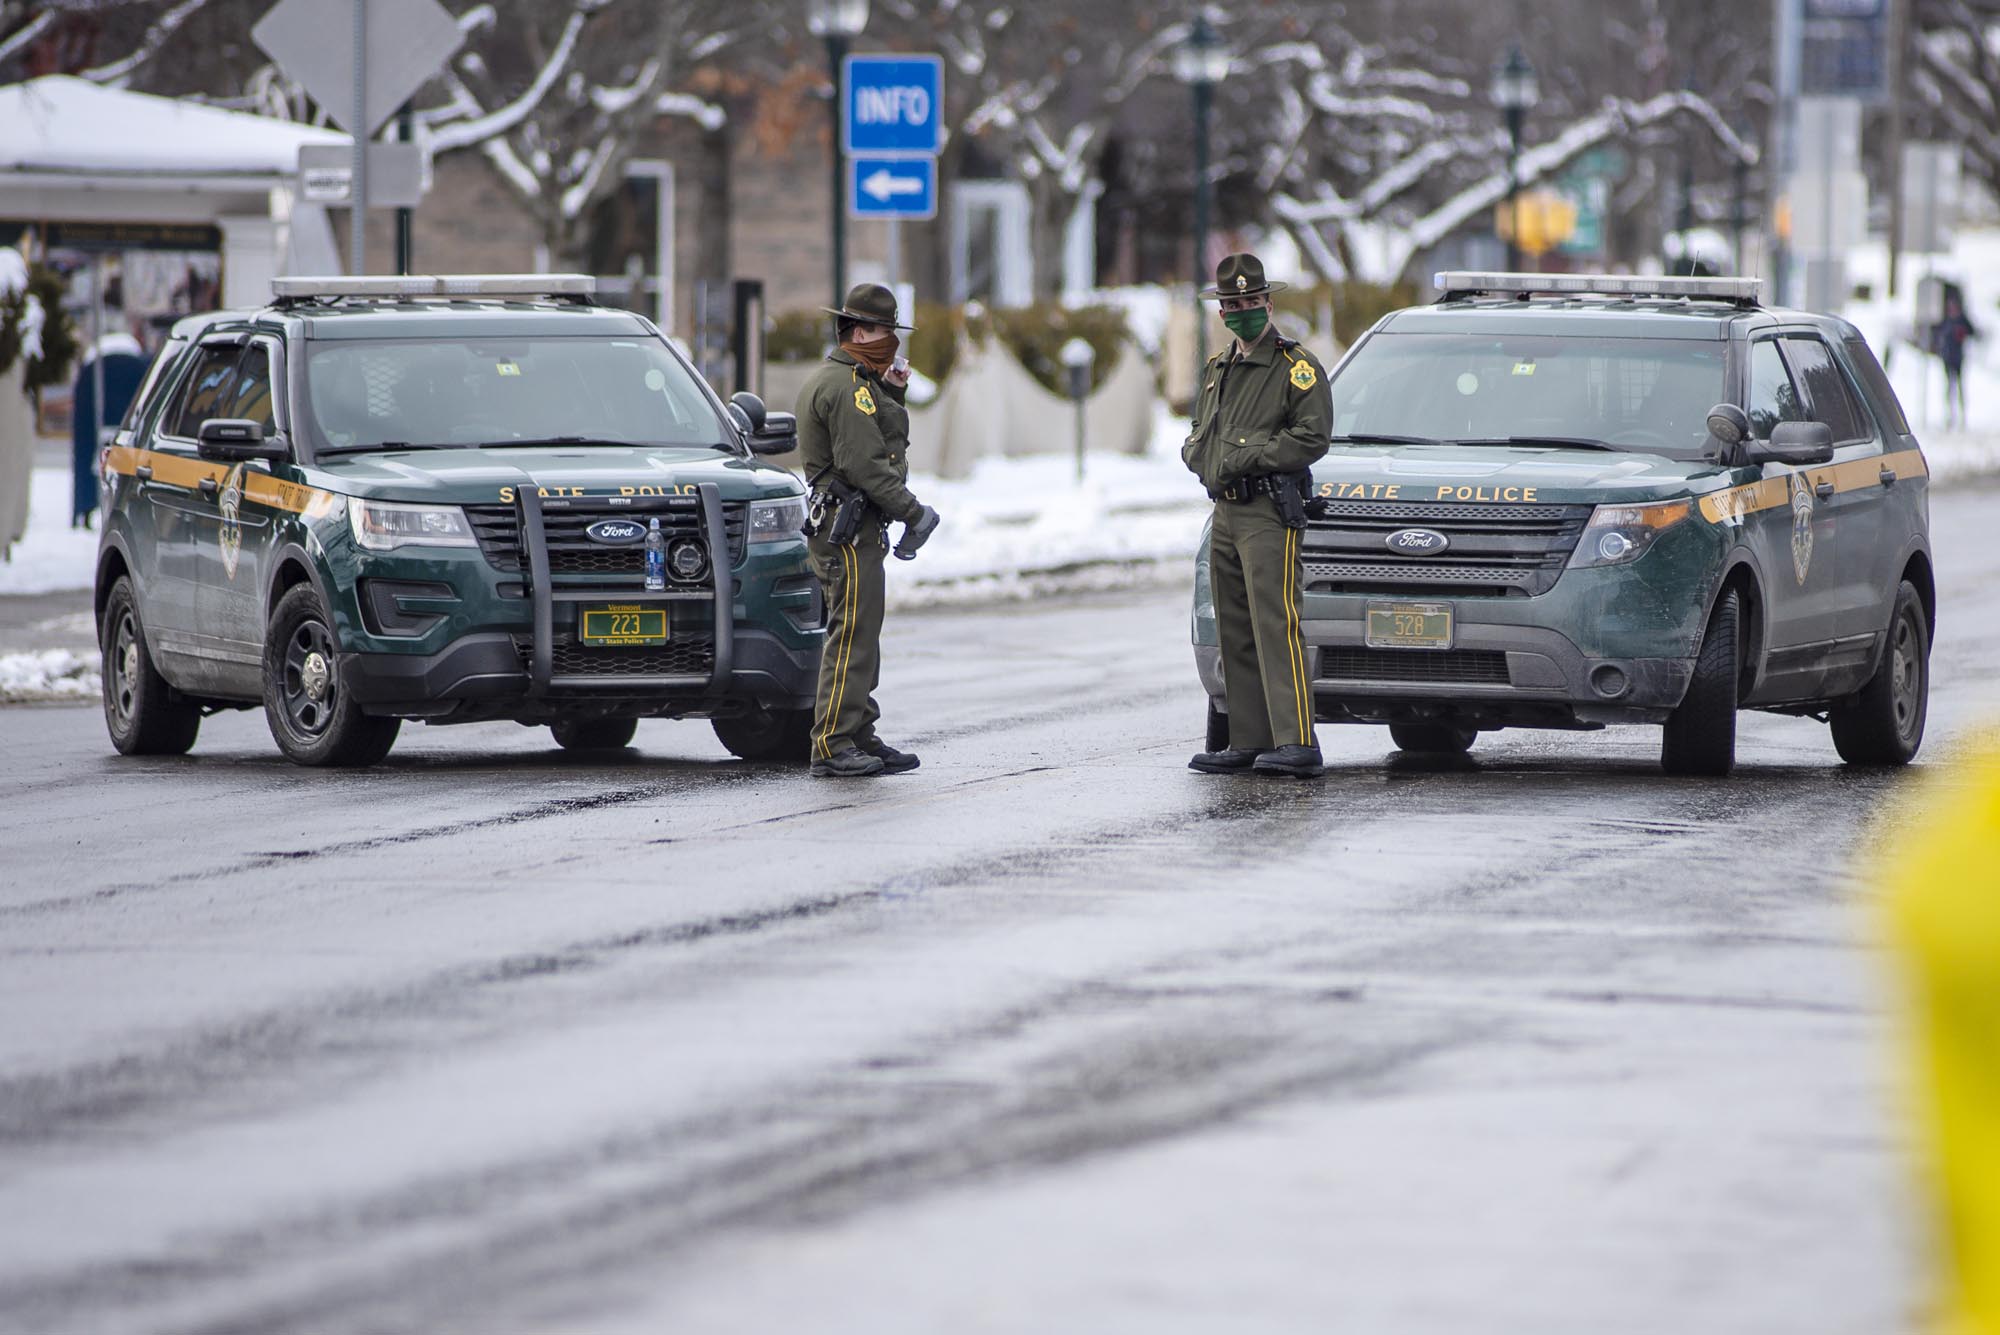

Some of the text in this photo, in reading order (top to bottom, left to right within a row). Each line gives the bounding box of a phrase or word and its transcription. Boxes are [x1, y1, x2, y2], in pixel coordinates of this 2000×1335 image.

[856, 86, 929, 125] INFO
[500, 486, 585, 503] SATE
[1318, 482, 1538, 502] STATE POLICE
[601, 525, 634, 537] Ford
[1399, 532, 1433, 547] Ford
[611, 614, 640, 635] 223
[1395, 615, 1424, 636] 528
